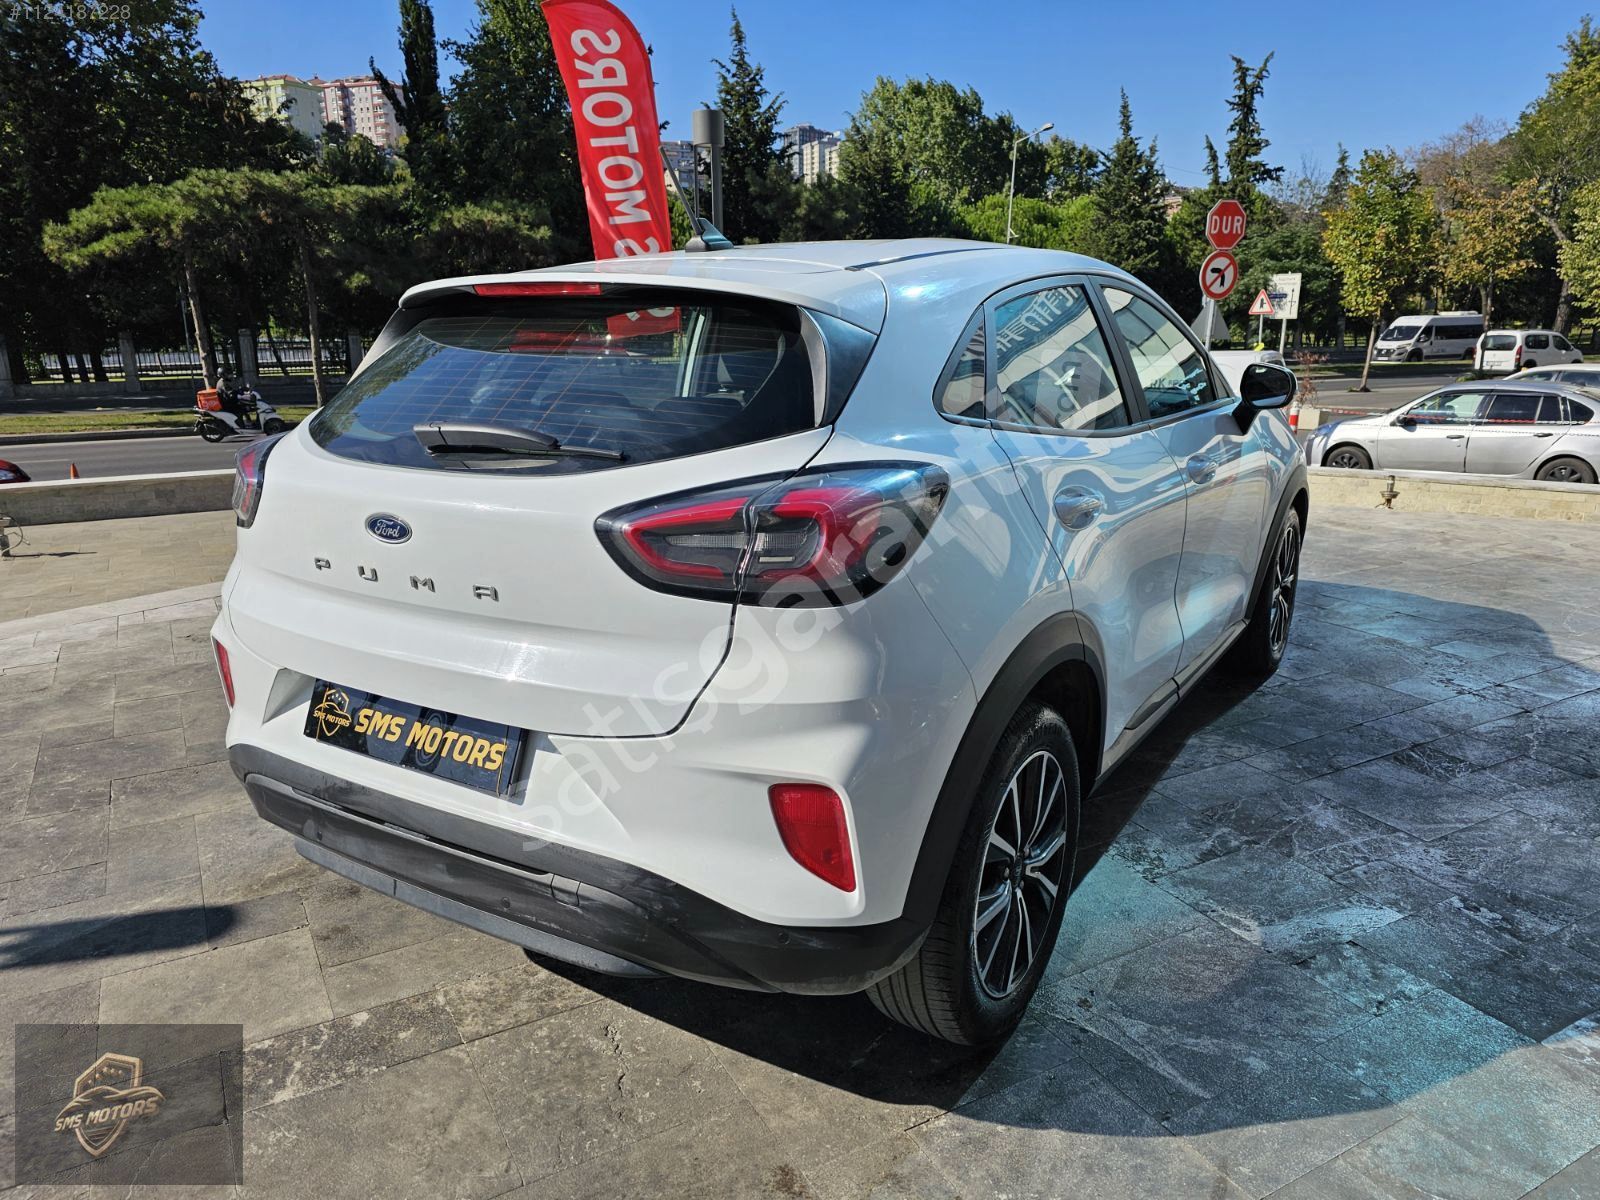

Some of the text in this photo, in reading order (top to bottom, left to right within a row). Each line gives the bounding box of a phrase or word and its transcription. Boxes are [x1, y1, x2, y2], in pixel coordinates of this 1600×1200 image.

[1210, 215, 1243, 235] DUR
[374, 519, 401, 538] Ford
[314, 556, 500, 602] PUMA
[313, 710, 351, 728] SMS MOTORS
[354, 707, 508, 772] SMS MOTORS
